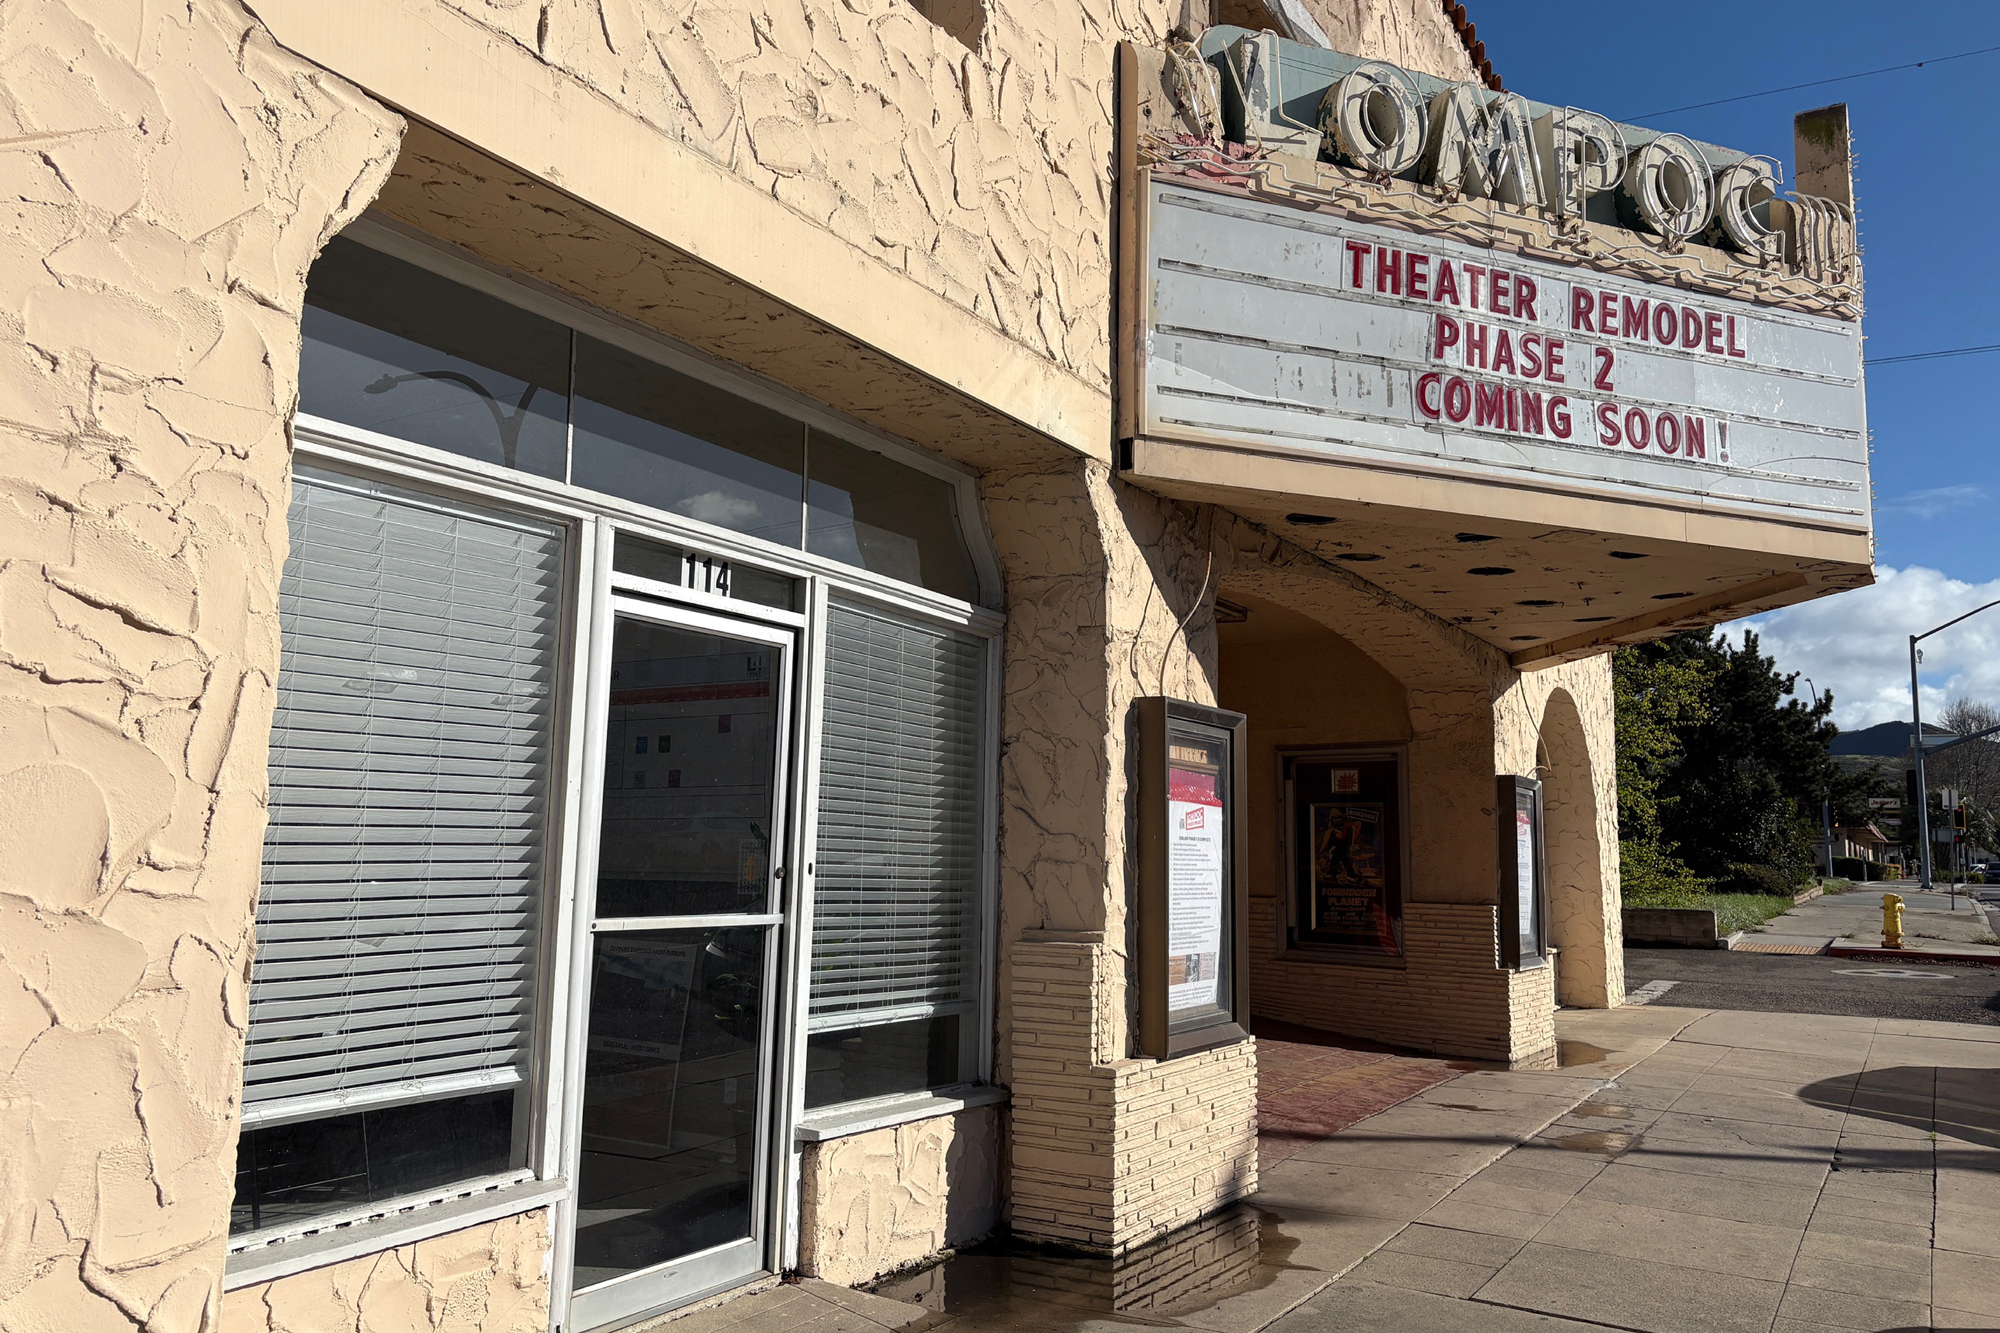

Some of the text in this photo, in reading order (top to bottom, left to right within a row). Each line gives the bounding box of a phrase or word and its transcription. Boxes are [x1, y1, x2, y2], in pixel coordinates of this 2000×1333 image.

[1223, 28, 1785, 264] LOMPOC
[1346, 240, 1746, 359] THEATER REMODEL
[1434, 313, 1615, 392] PHASE 2
[1415, 371, 1573, 440] COMING
[686, 552, 729, 597] 114
[1321, 887, 1377, 897] FORBIDDEN
[1327, 897, 1369, 906] PLANET
[665, 949, 687, 958] PARKING
[645, 1045, 661, 1054] SPACE
